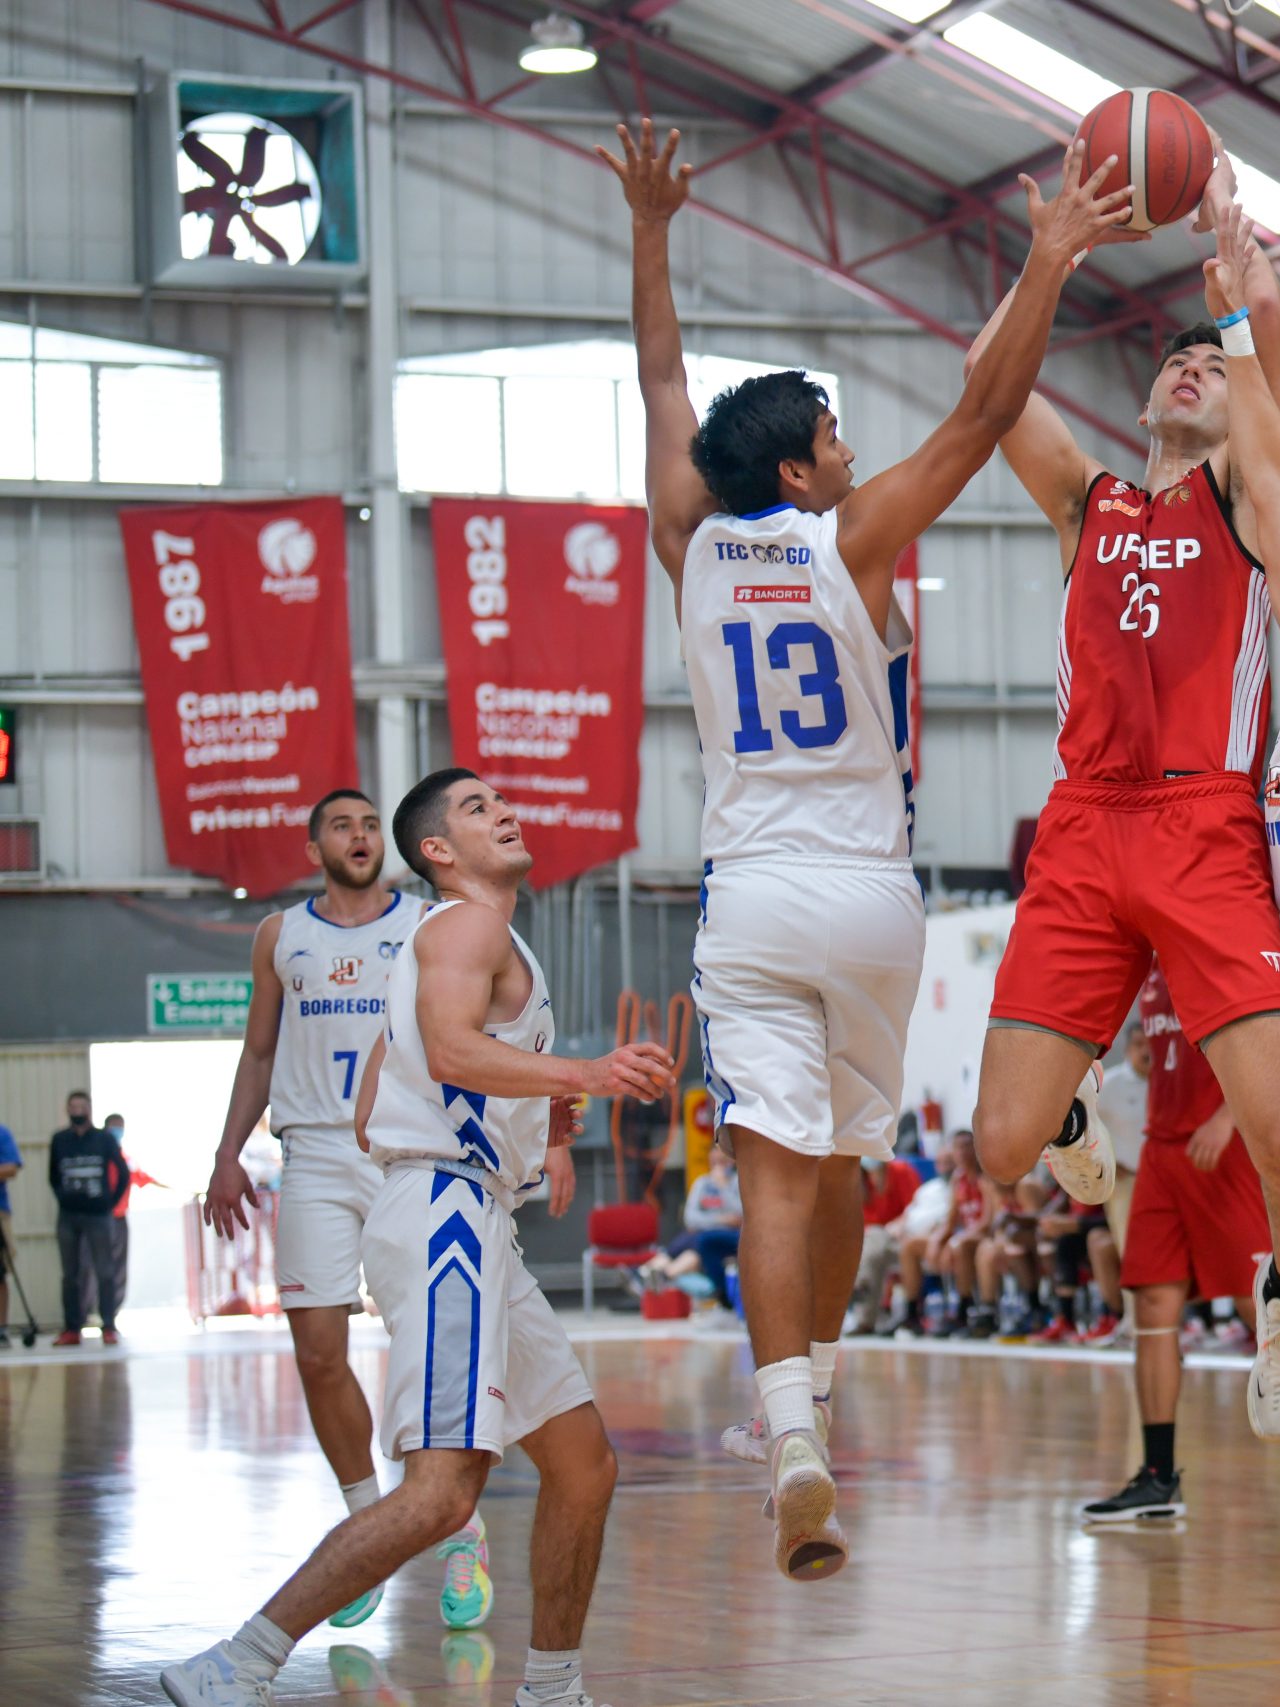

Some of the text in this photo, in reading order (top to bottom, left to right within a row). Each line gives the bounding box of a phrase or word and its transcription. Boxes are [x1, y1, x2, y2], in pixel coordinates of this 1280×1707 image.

[464, 515, 509, 646] 1982
[715, 542, 749, 561] TEC
[153, 530, 210, 662] 1987
[754, 590, 808, 600] BANORTE
[1119, 572, 1160, 639] 26
[721, 622, 848, 753] 13
[333, 1051, 358, 1099] 7
